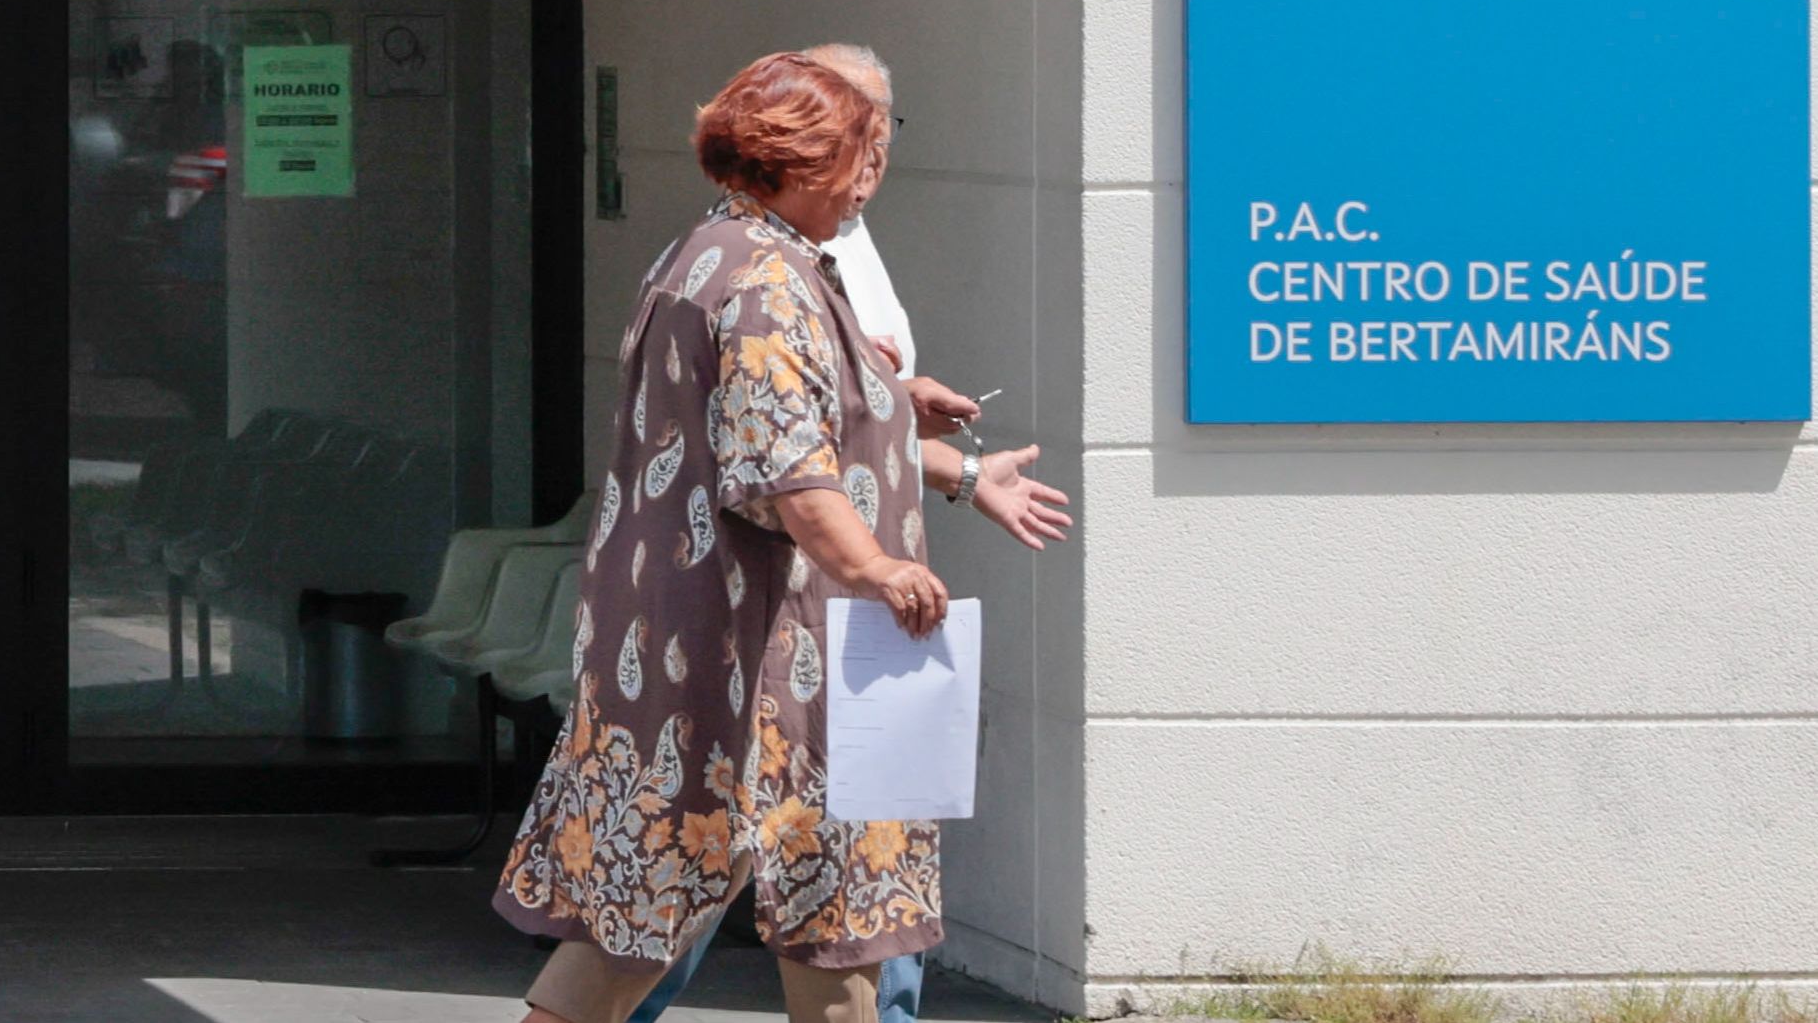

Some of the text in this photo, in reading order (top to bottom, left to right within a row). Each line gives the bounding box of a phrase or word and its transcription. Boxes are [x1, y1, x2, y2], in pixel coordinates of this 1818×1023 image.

[254, 83, 341, 96] HORARIO
[1250, 201, 1380, 242] P.A.C.
[1248, 249, 1707, 302] CENTRO DE SAÚDE
[1250, 309, 1671, 362] DE BERTAMIRÁNS
